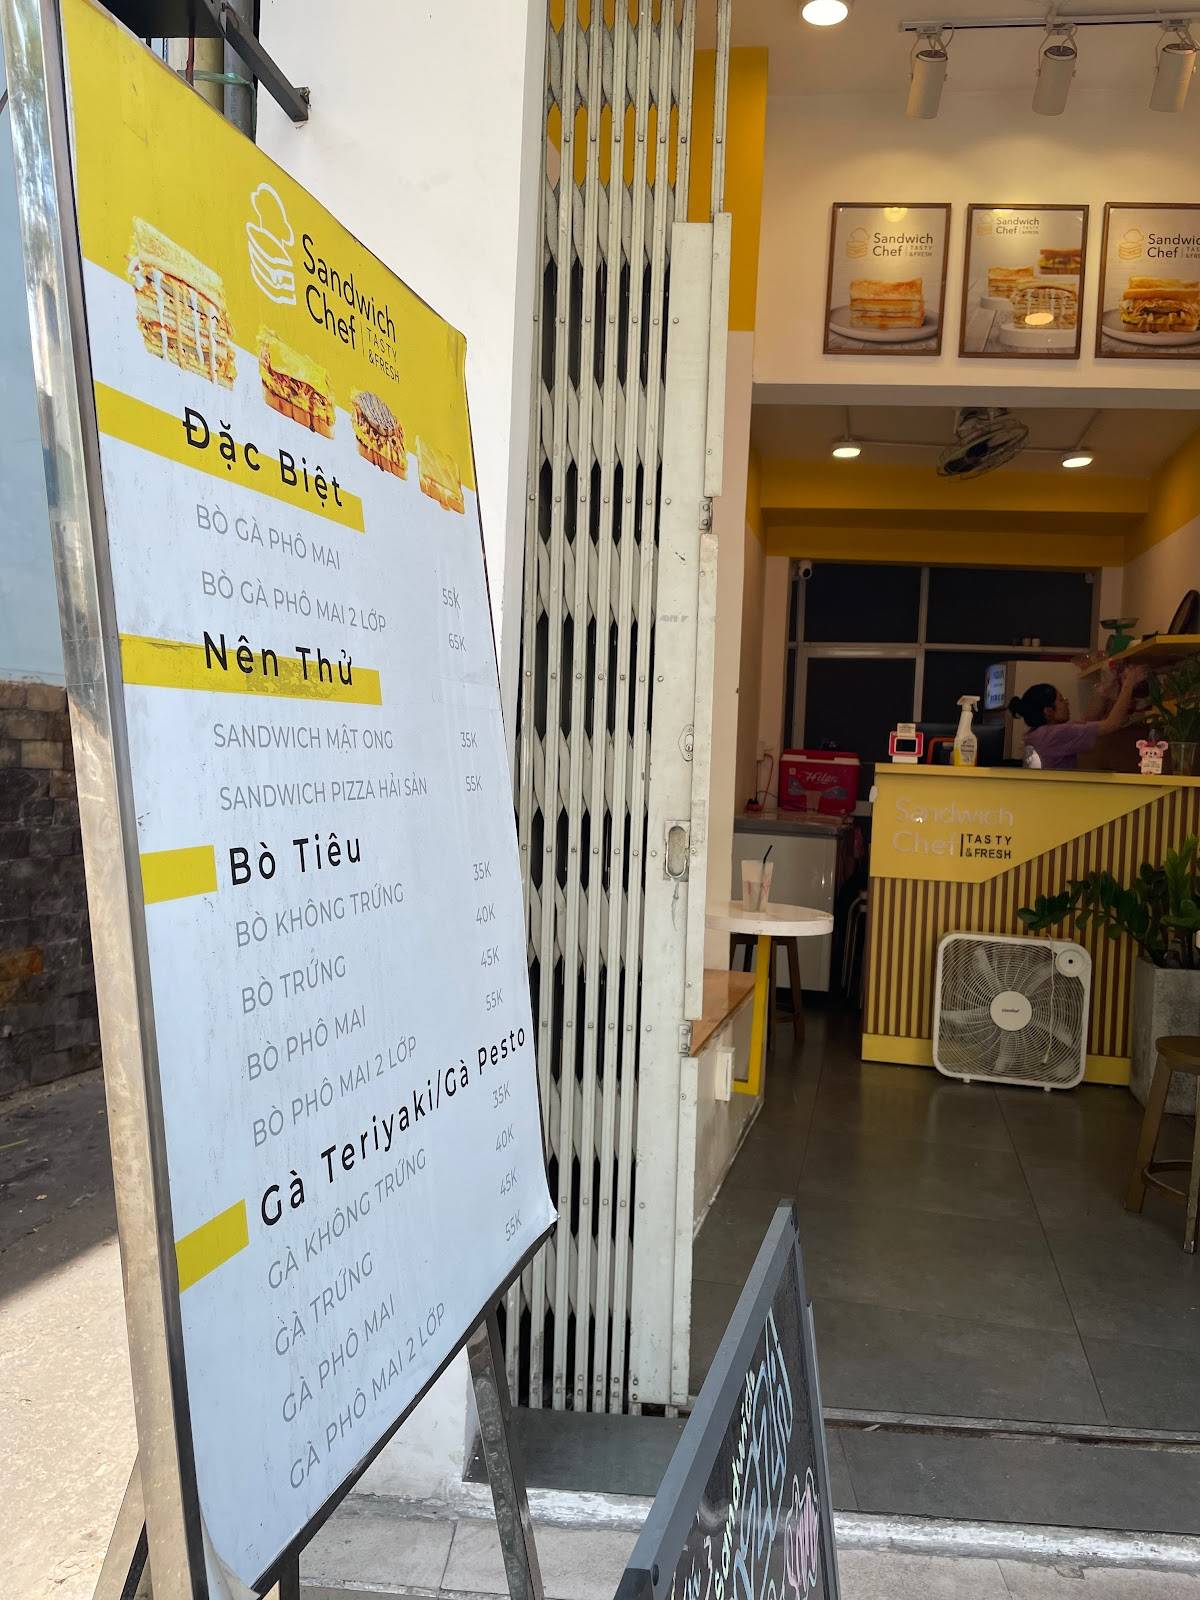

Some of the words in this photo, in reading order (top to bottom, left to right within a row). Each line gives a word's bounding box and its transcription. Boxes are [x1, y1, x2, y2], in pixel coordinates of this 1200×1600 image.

[996, 226, 1018, 234] Chef
[997, 217, 1040, 226] Sandwich
[873, 232, 934, 245] Sandwich
[873, 245, 903, 257] Chef
[1147, 246, 1179, 258] Chef
[302, 233, 396, 343] Sandwich
[306, 284, 356, 350] Chef
[366, 327, 397, 363] TASTY
[368, 349, 400, 384] &FRESH
[182, 406, 261, 471] Đặc
[279, 448, 343, 508] Biệt
[196, 503, 228, 535] BÒ
[235, 516, 264, 547] GÀ
[269, 527, 307, 559] PHÔ
[312, 542, 341, 570] MAI
[201, 569, 233, 600] BÒ
[240, 579, 268, 608] GÀ
[273, 587, 312, 617] PHÔ
[317, 599, 345, 625] MAI
[348, 607, 357, 627] 2
[360, 609, 386, 633] LỚP
[442, 584, 461, 609] 55K
[448, 633, 467, 652] 65K
[203, 631, 279, 677] Nên
[296, 646, 353, 686] Thử
[213, 723, 321, 749] SANDWICH
[326, 723, 358, 753] MẬT
[362, 729, 393, 750] ONG
[460, 731, 478, 749] 35K
[219, 781, 325, 811] SANDWICH
[331, 779, 375, 802] PIZZA
[378, 772, 401, 799] HẢI
[404, 771, 427, 796] SẢN
[465, 775, 483, 792] 55K
[896, 798, 1014, 827] Sandwich
[893, 831, 955, 856] Chef
[966, 848, 1012, 860] &FRESH
[967, 834, 1012, 846] TASTY
[229, 841, 276, 886] Bò
[292, 832, 361, 873] Tiêu
[472, 861, 492, 882] 35K
[236, 911, 268, 948] BÒ
[275, 898, 345, 937] KHÔNG
[349, 882, 404, 916] TRỨNG
[475, 903, 496, 925] 40K
[480, 945, 500, 968] 45K
[241, 976, 273, 1014] BÒ
[280, 955, 346, 998] TRỨNG
[485, 988, 504, 1012] 55K
[247, 1040, 279, 1081] BÒ
[286, 1018, 328, 1062] PHÔ
[334, 1005, 366, 1039] MAI
[252, 1105, 284, 1148] BÒ
[291, 1077, 333, 1125] PHÔ
[339, 1060, 371, 1097] MAI
[375, 1054, 385, 1076] 2
[388, 1035, 417, 1069] LỚP
[492, 1081, 512, 1109] 35K
[260, 1169, 305, 1226] Gà
[320, 1059, 470, 1184] Teriyaki/Gà
[477, 1027, 525, 1075] Pesto
[495, 1124, 515, 1153] 40K
[500, 1168, 518, 1196] 45K
[268, 1245, 299, 1289] GÀ
[304, 1191, 371, 1262] KHÔNG
[374, 1148, 426, 1202] TRỨNG
[504, 1209, 523, 1242] 55K
[275, 1310, 306, 1356] GÀ
[309, 1252, 373, 1324] TRỨNG
[282, 1376, 313, 1423] GÀ
[318, 1328, 358, 1389] PHÔ
[364, 1294, 394, 1343] MAI
[290, 1440, 320, 1488] GÀ
[326, 1388, 366, 1452] PHÔ
[371, 1350, 402, 1401] MAI
[405, 1337, 416, 1362] 2
[417, 1302, 445, 1347] LỚP
